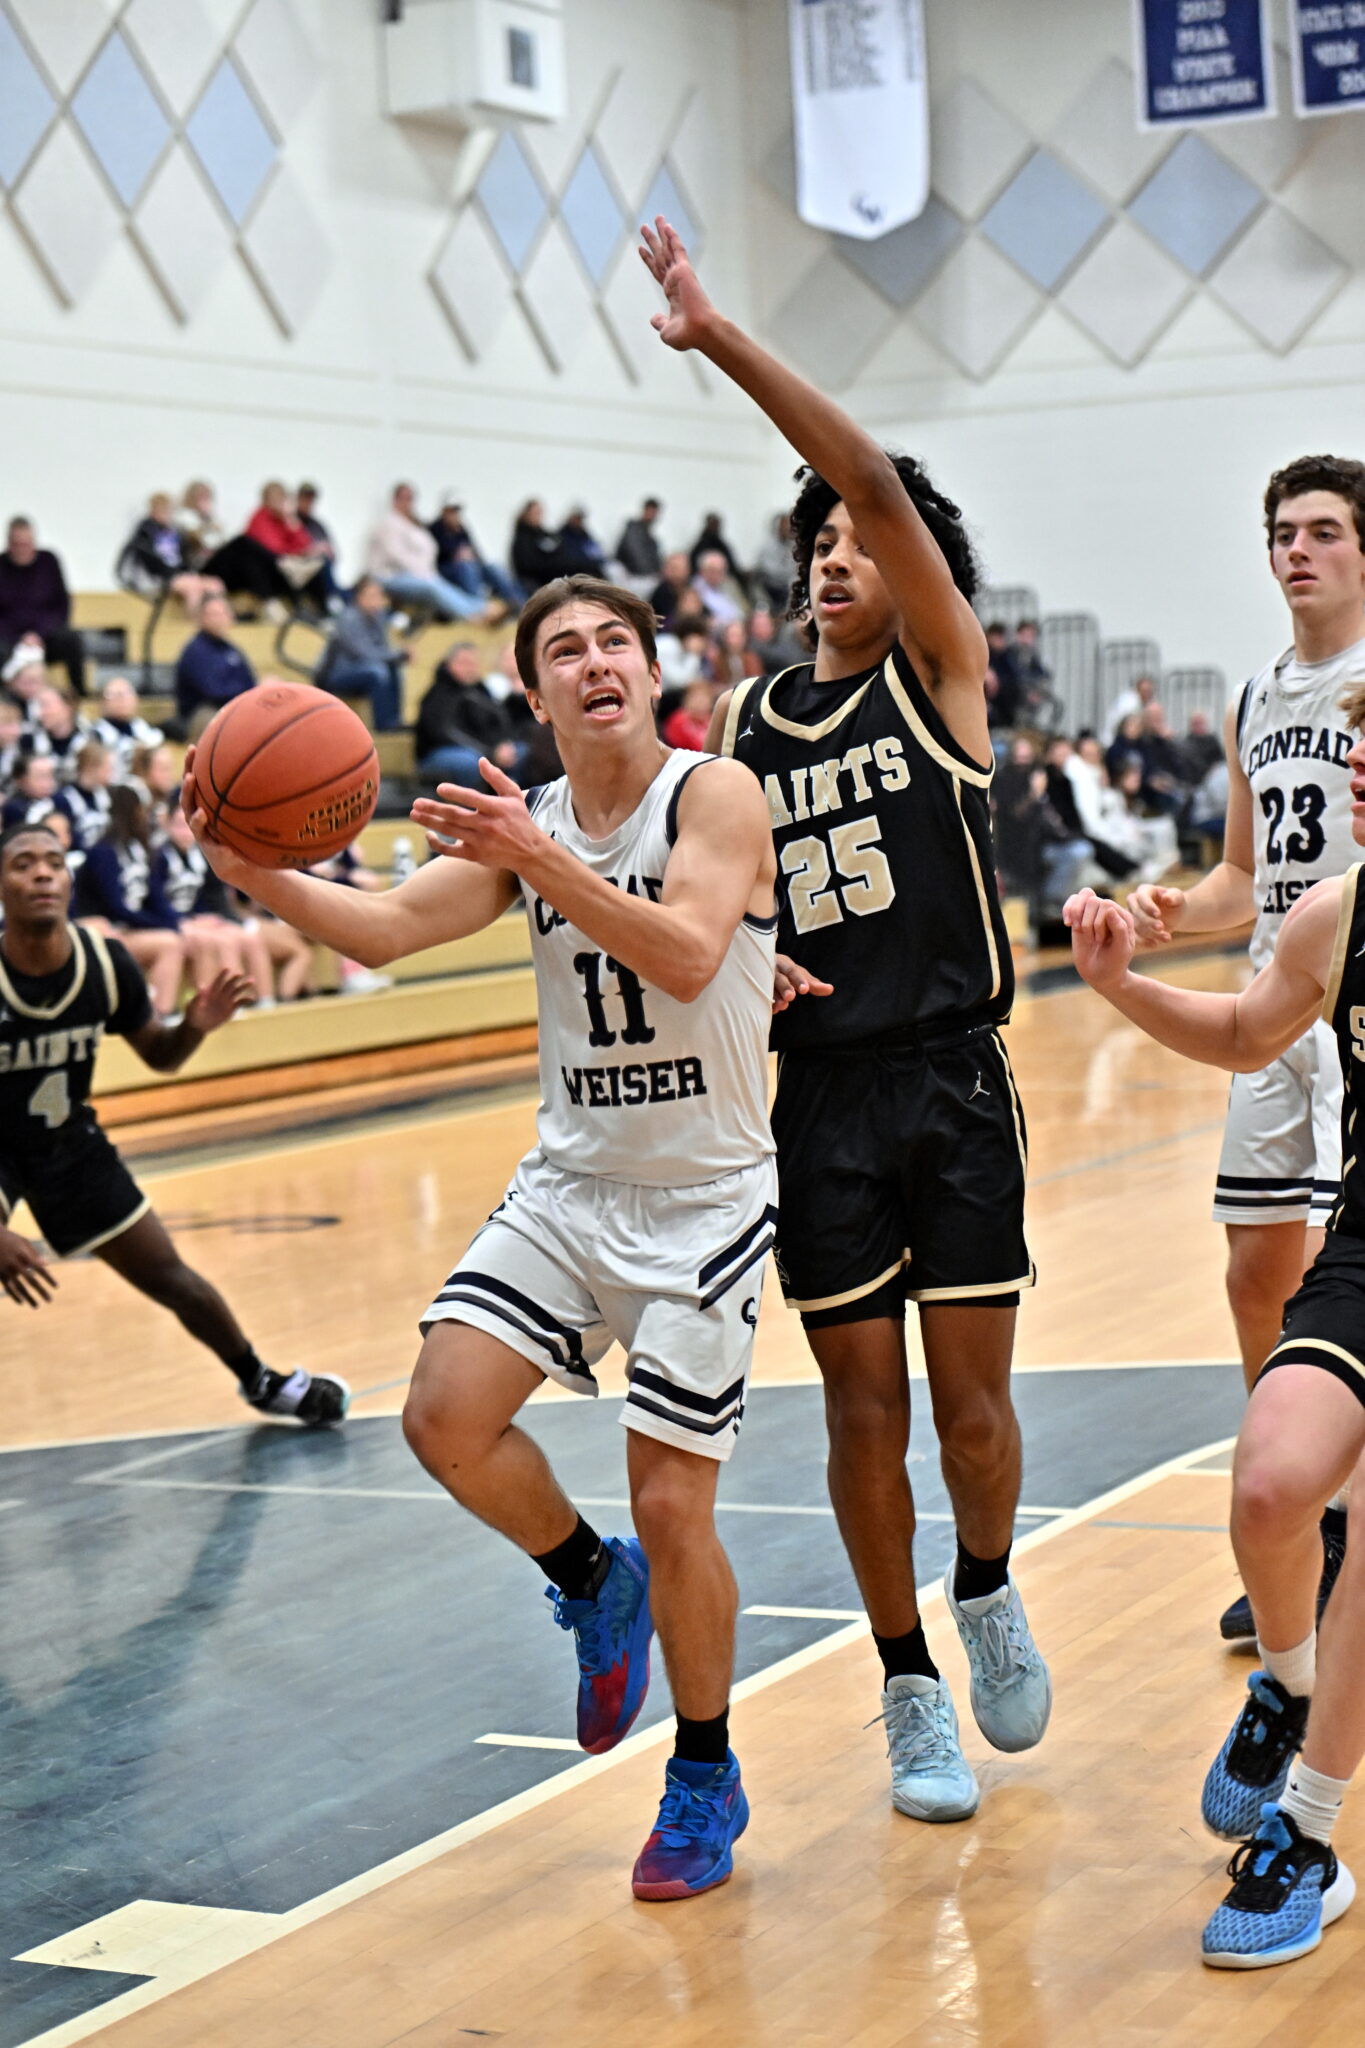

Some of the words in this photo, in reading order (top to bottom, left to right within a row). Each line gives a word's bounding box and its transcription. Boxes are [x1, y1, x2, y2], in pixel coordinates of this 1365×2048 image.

[764, 736, 911, 829] AINTS
[1248, 726, 1354, 778] CONRAD
[1259, 783, 1327, 867] 23
[780, 815, 896, 935] 25
[573, 952, 656, 1047] 11
[28, 1071, 71, 1129] 4
